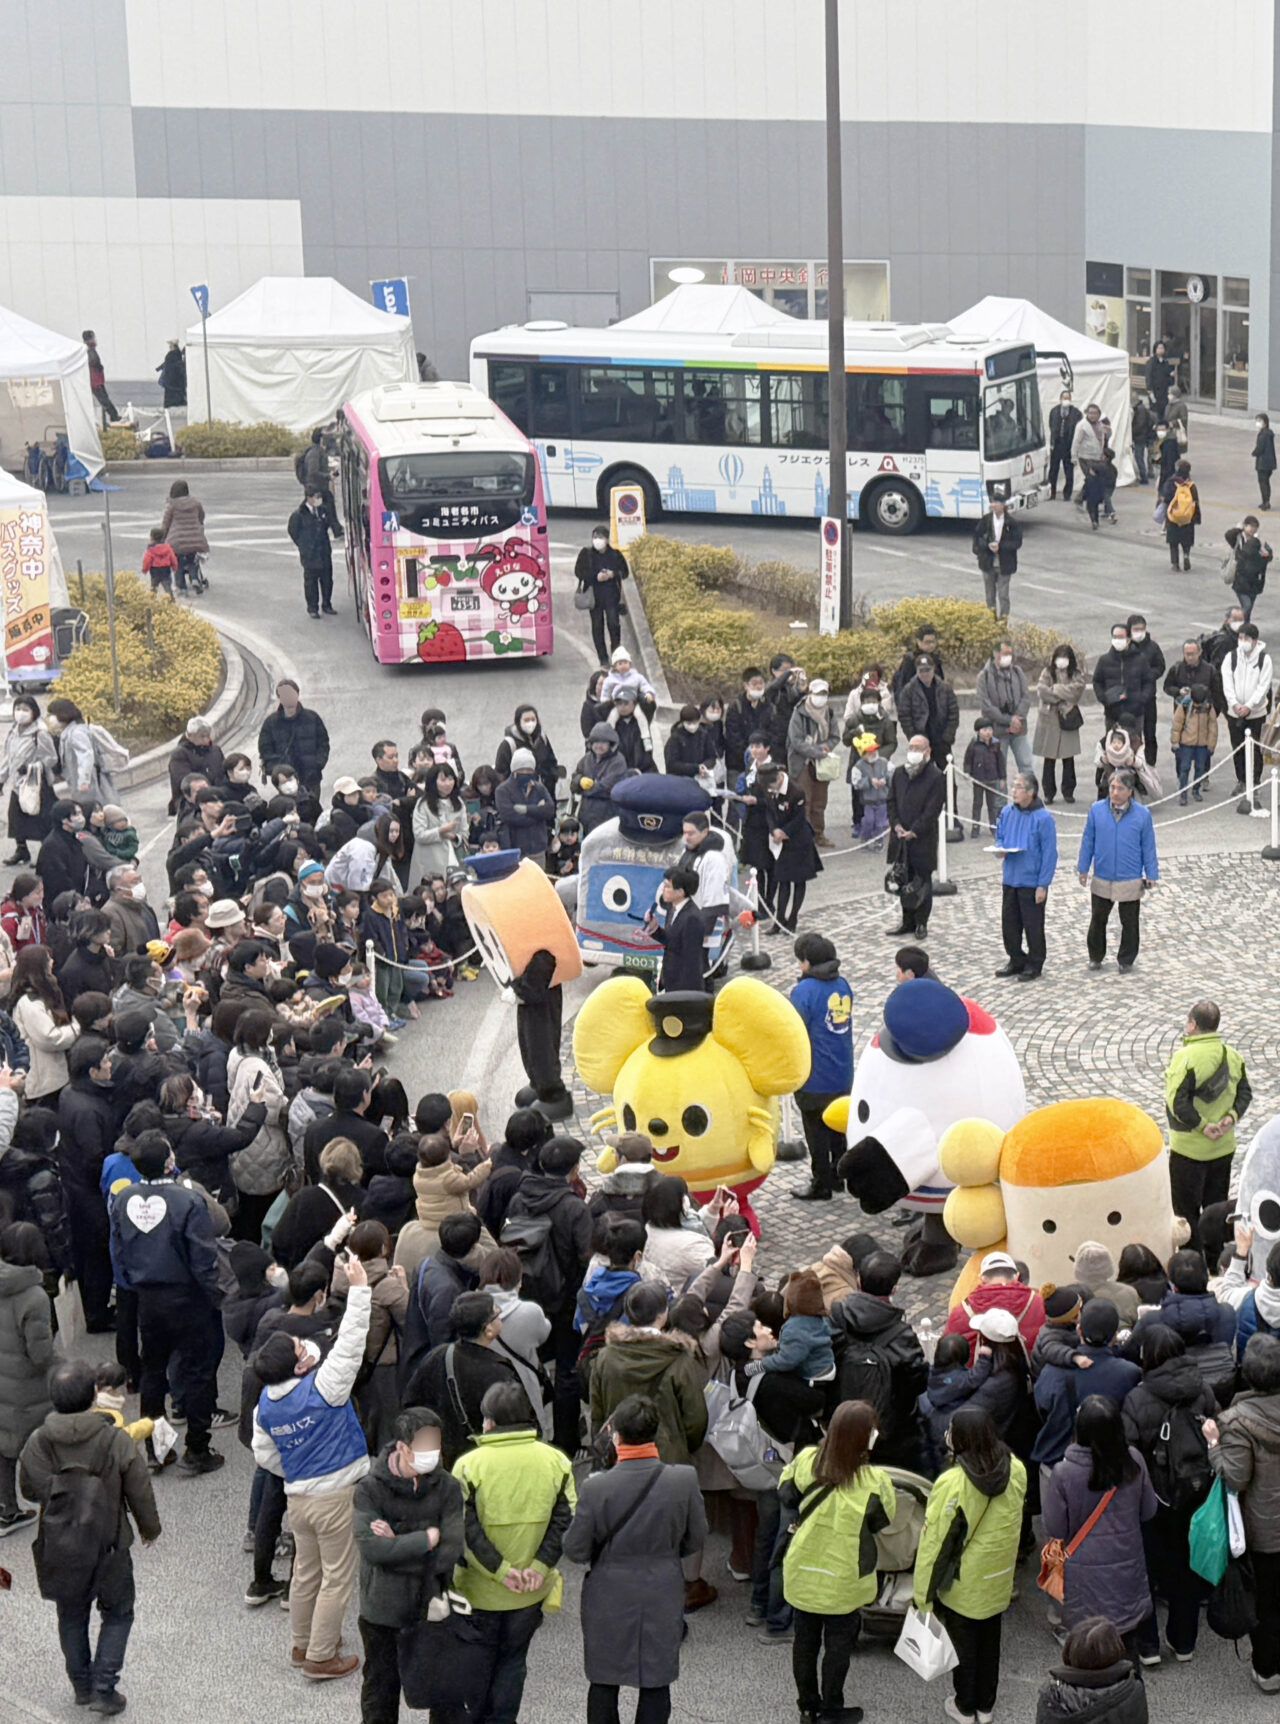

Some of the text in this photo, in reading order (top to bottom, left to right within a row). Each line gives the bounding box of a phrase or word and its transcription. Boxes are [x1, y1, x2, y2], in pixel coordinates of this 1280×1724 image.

[440, 505, 480, 517] 海老名市
[421, 515, 500, 528] コミュニティバス
[19, 511, 45, 580] 神奈中
[0, 522, 23, 616] バスグッズ
[494, 562, 521, 578] えびな
[625, 955, 656, 969] 2003
